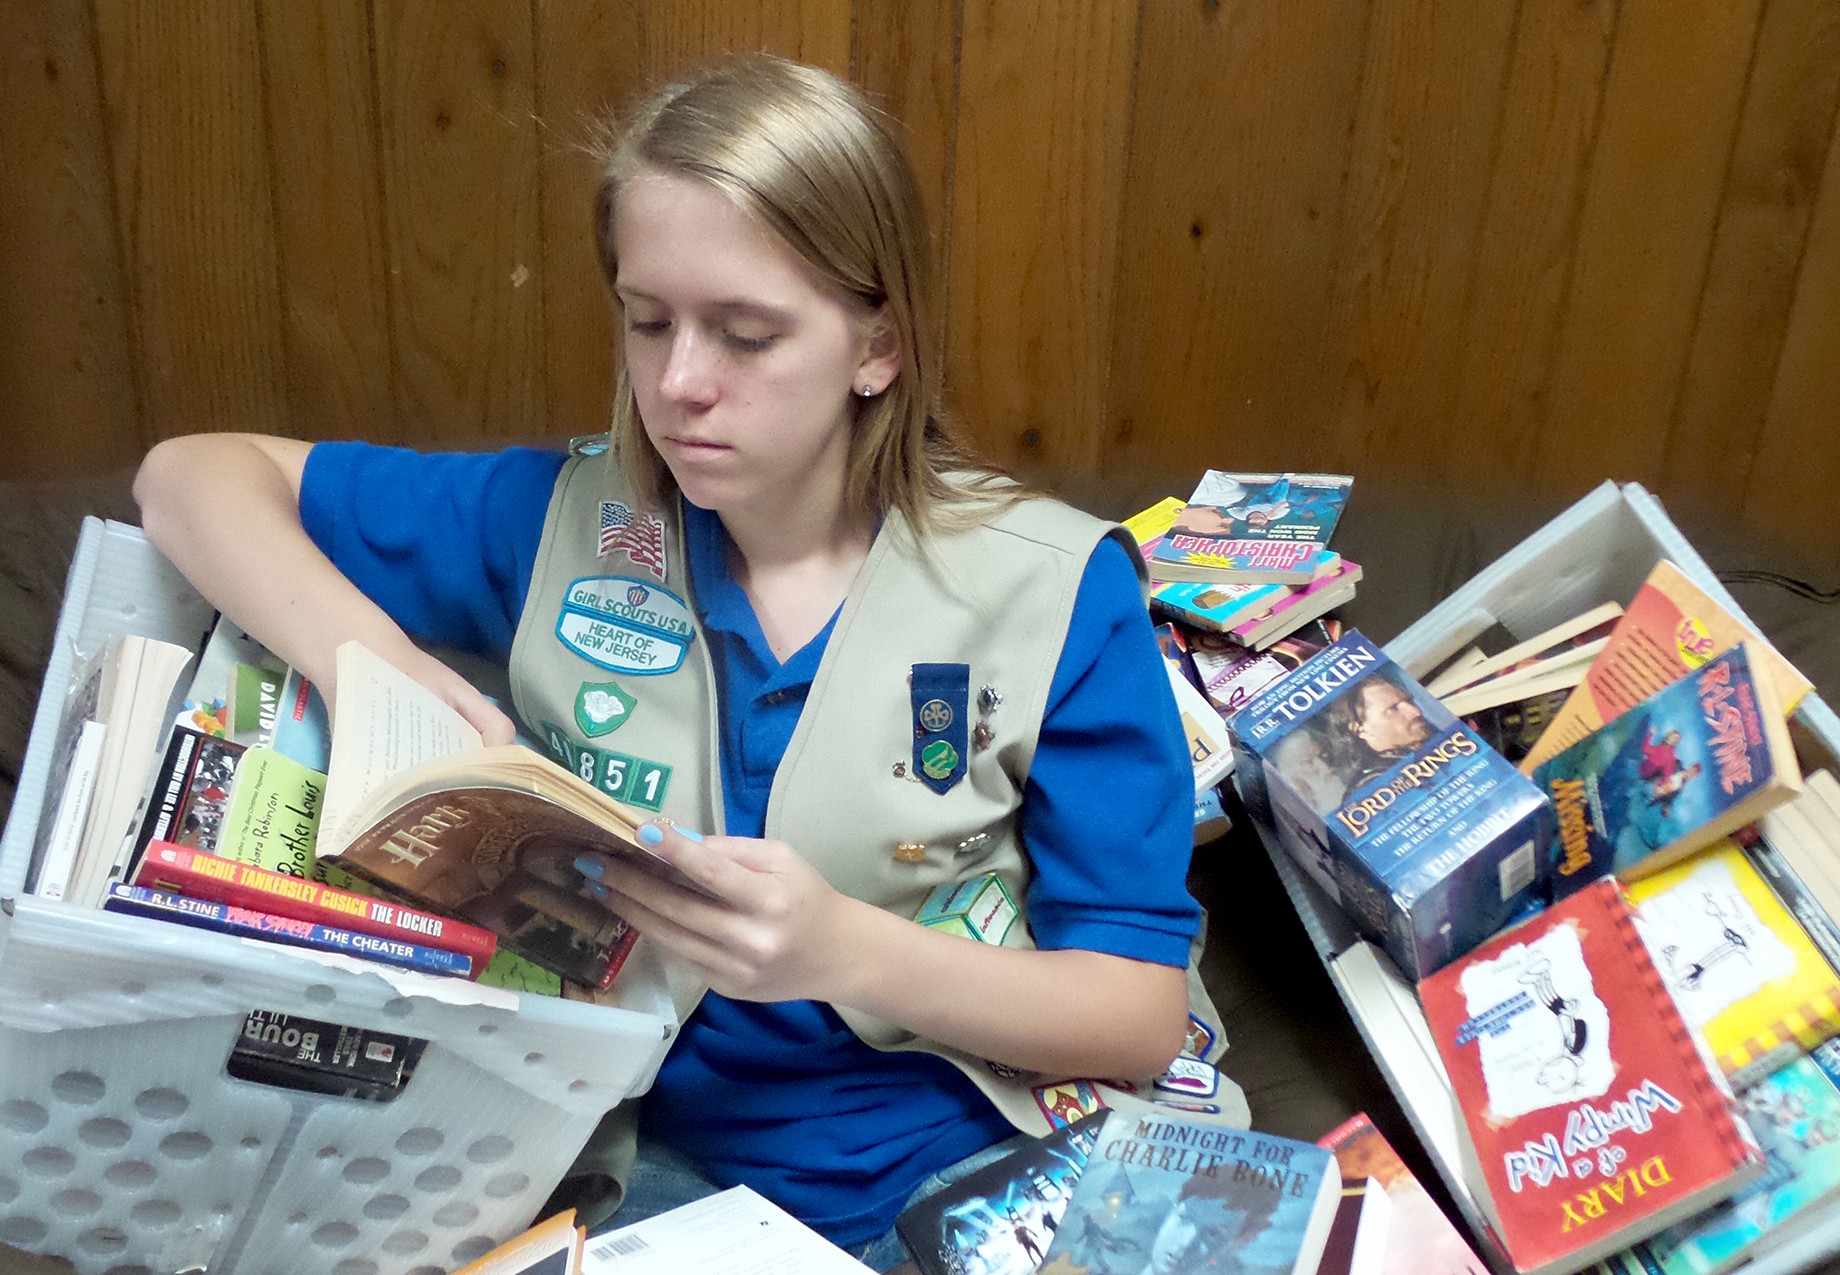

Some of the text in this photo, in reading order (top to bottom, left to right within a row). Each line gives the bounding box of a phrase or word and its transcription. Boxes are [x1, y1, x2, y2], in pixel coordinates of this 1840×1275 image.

[1170, 534, 1314, 561] CHRISTOPHER
[573, 589, 688, 634] GIRL SCOUTS USA
[574, 631, 658, 666] NEW JERSEY
[588, 622, 655, 652] HEART OF
[1272, 645, 1376, 722] TOLKIEN
[1295, 673, 1311, 687] NEW
[1310, 663, 1325, 676] LINE
[1324, 646, 1349, 666] CINEMA
[259, 682, 276, 728] DAVID
[171, 771, 184, 783] BY
[254, 771, 265, 790] Pageant
[259, 759, 268, 771] Ever
[1336, 785, 1397, 838] LORD
[1402, 731, 1478, 787] RINGS
[162, 803, 174, 813] &
[248, 790, 260, 814] Christmas
[251, 792, 279, 838] Robinson
[1371, 758, 1490, 849] THE FELLOWSHIP OF THE RING
[1393, 777, 1499, 859] THE RETURN OF THE KING
[1401, 781, 1476, 840] THE TWO TOWERS
[278, 779, 320, 878] Brother Louis
[379, 803, 473, 869] Harry
[1423, 844, 1460, 878] THE
[1457, 806, 1512, 853] HOBBIT
[1447, 819, 1469, 839] AND
[191, 854, 443, 937] RICHIE TANKERSLEY CUSICK THE LOCKER
[323, 929, 350, 945] THE
[352, 935, 415, 959] CHEATER
[297, 1051, 321, 1064] THE
[1134, 1120, 1296, 1167] MIDNIGHT FOR
[1504, 1079, 1683, 1192] Wimpy Kid
[1105, 1138, 1310, 1199] CHARLIE BONE
[1572, 1146, 1627, 1178] of a
[1561, 1155, 1673, 1232] DIARY
